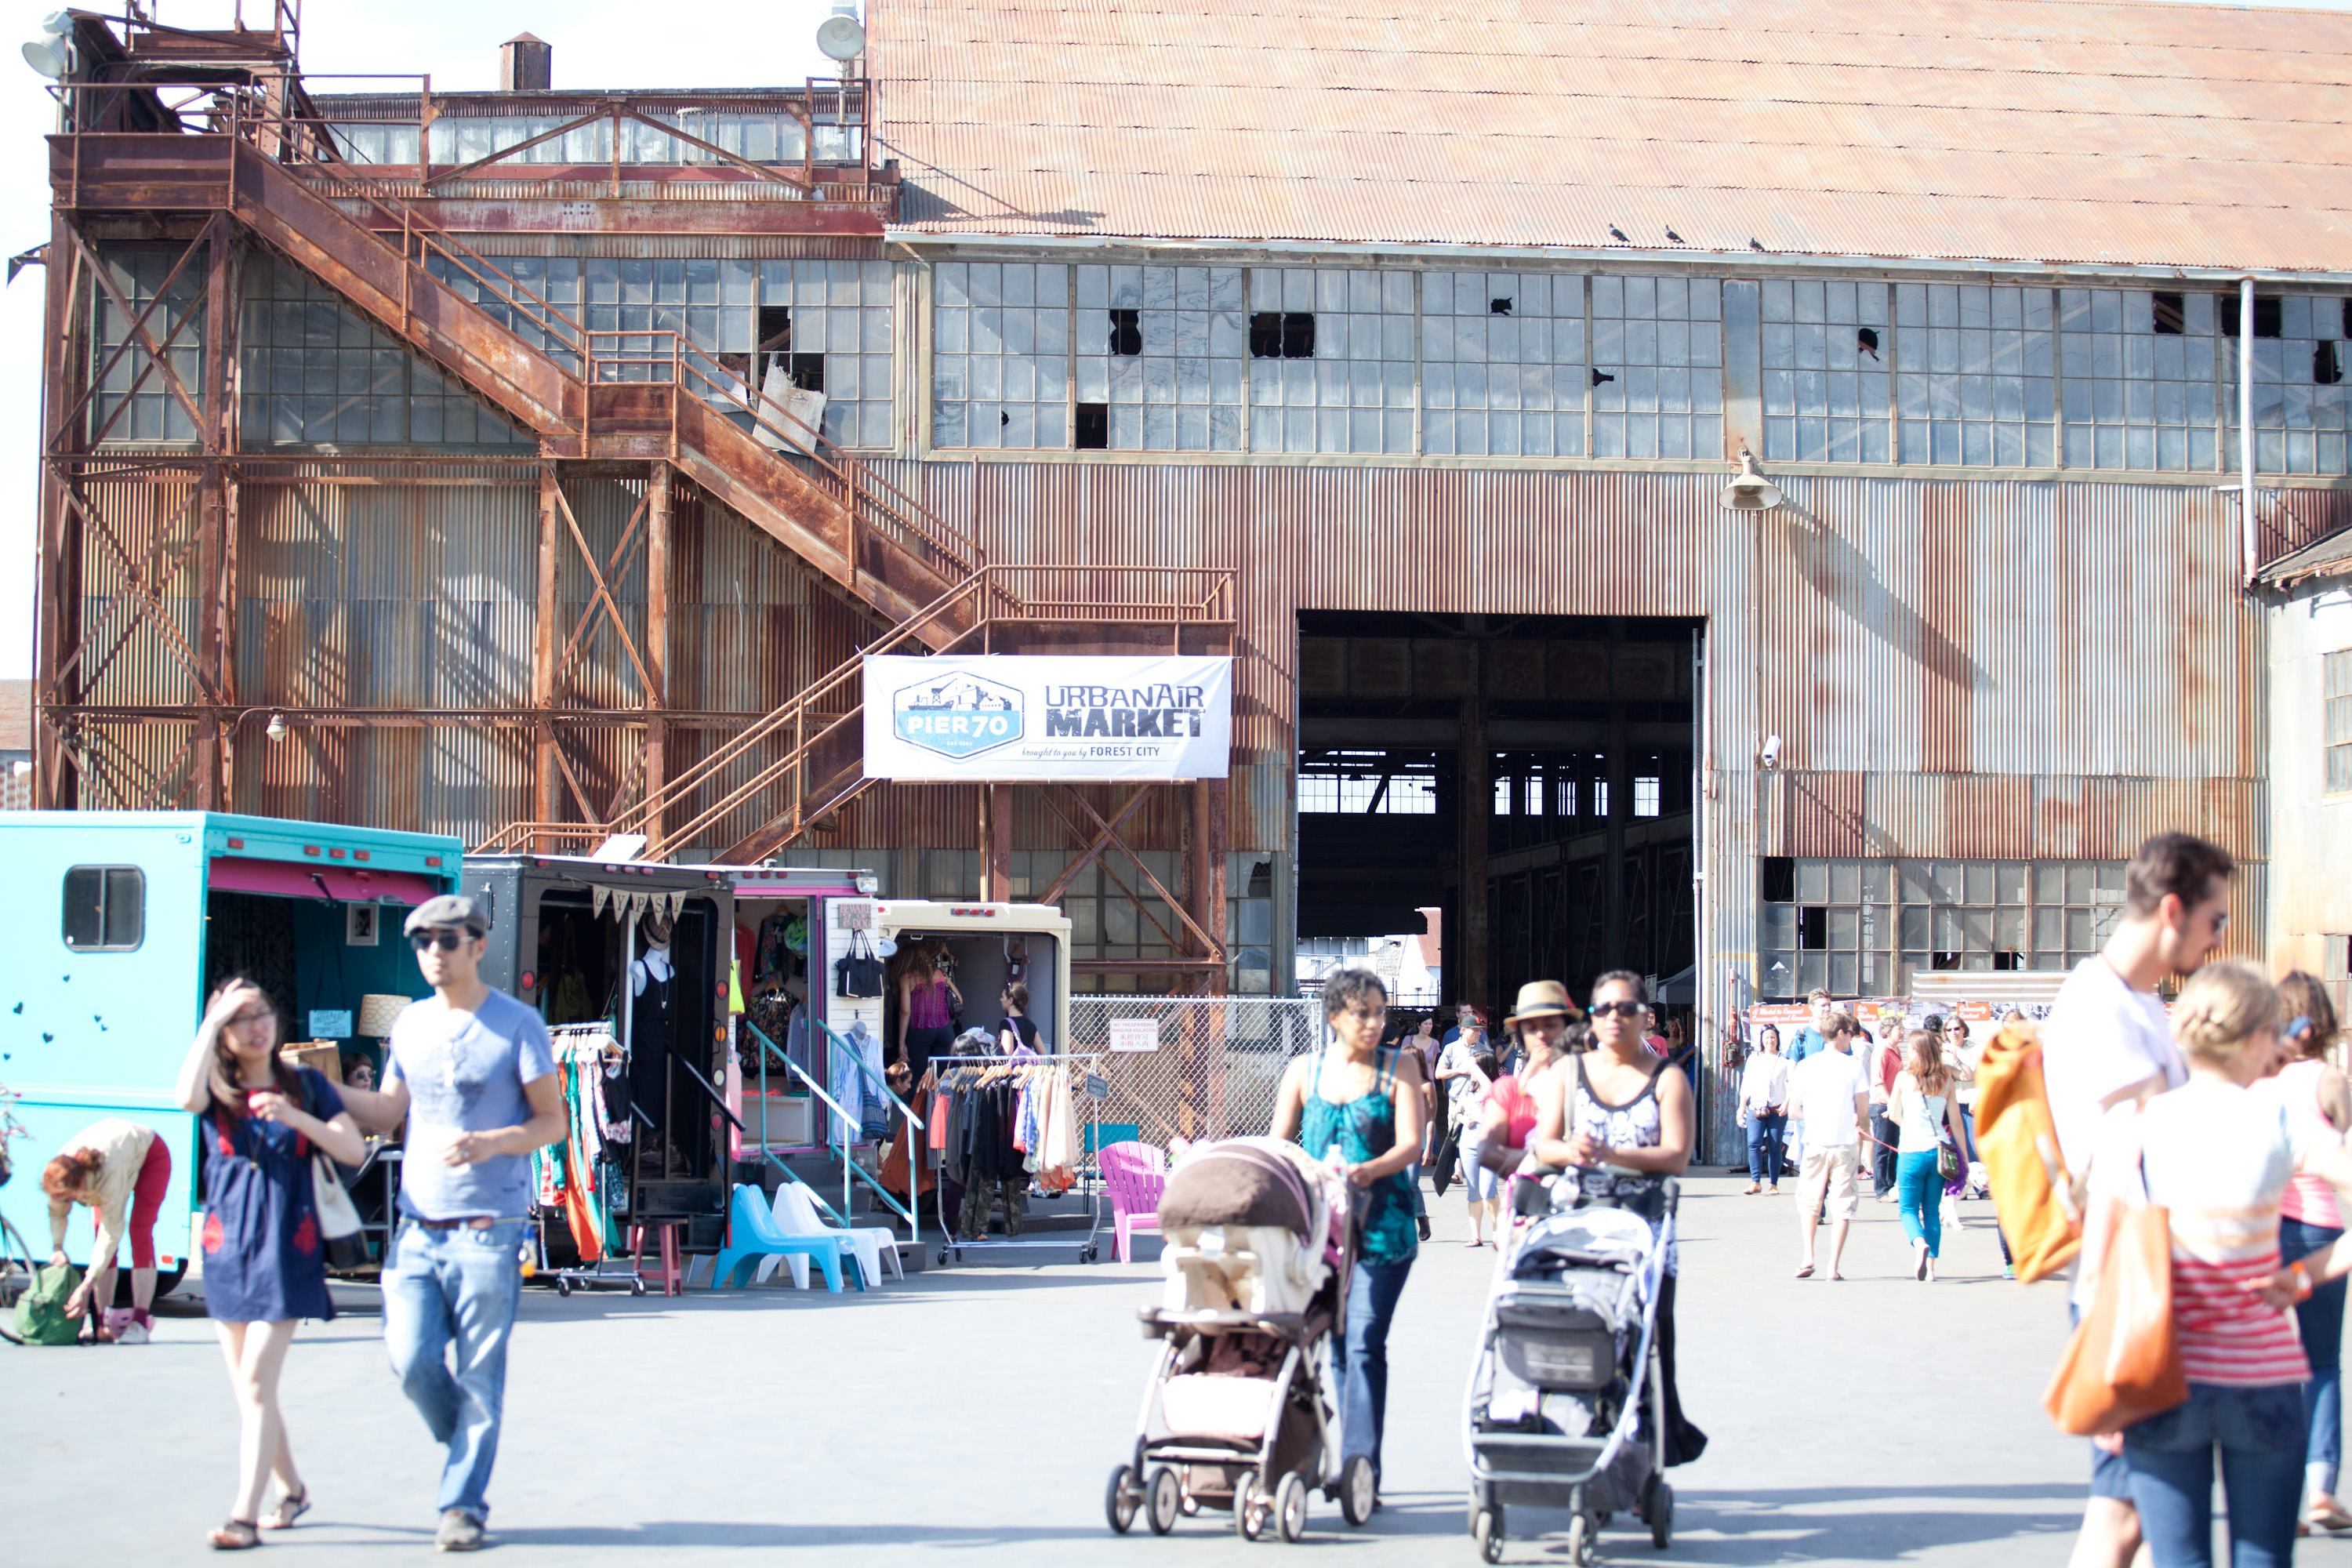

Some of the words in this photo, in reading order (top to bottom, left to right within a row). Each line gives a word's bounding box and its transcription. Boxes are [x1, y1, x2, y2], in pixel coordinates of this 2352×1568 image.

[908, 716, 969, 734] PIER
[971, 716, 1008, 738] 70
[1046, 709, 1206, 737] MARKET
[1022, 747, 1052, 759] brought
[1062, 750, 1076, 759] you
[1079, 747, 1087, 759] by
[1091, 746, 1133, 756] FOREST
[1136, 746, 1160, 756] CITY
[595, 891, 681, 913] GYPSY
[840, 903, 871, 913] BEWARE
[852, 918, 871, 928] DOG
